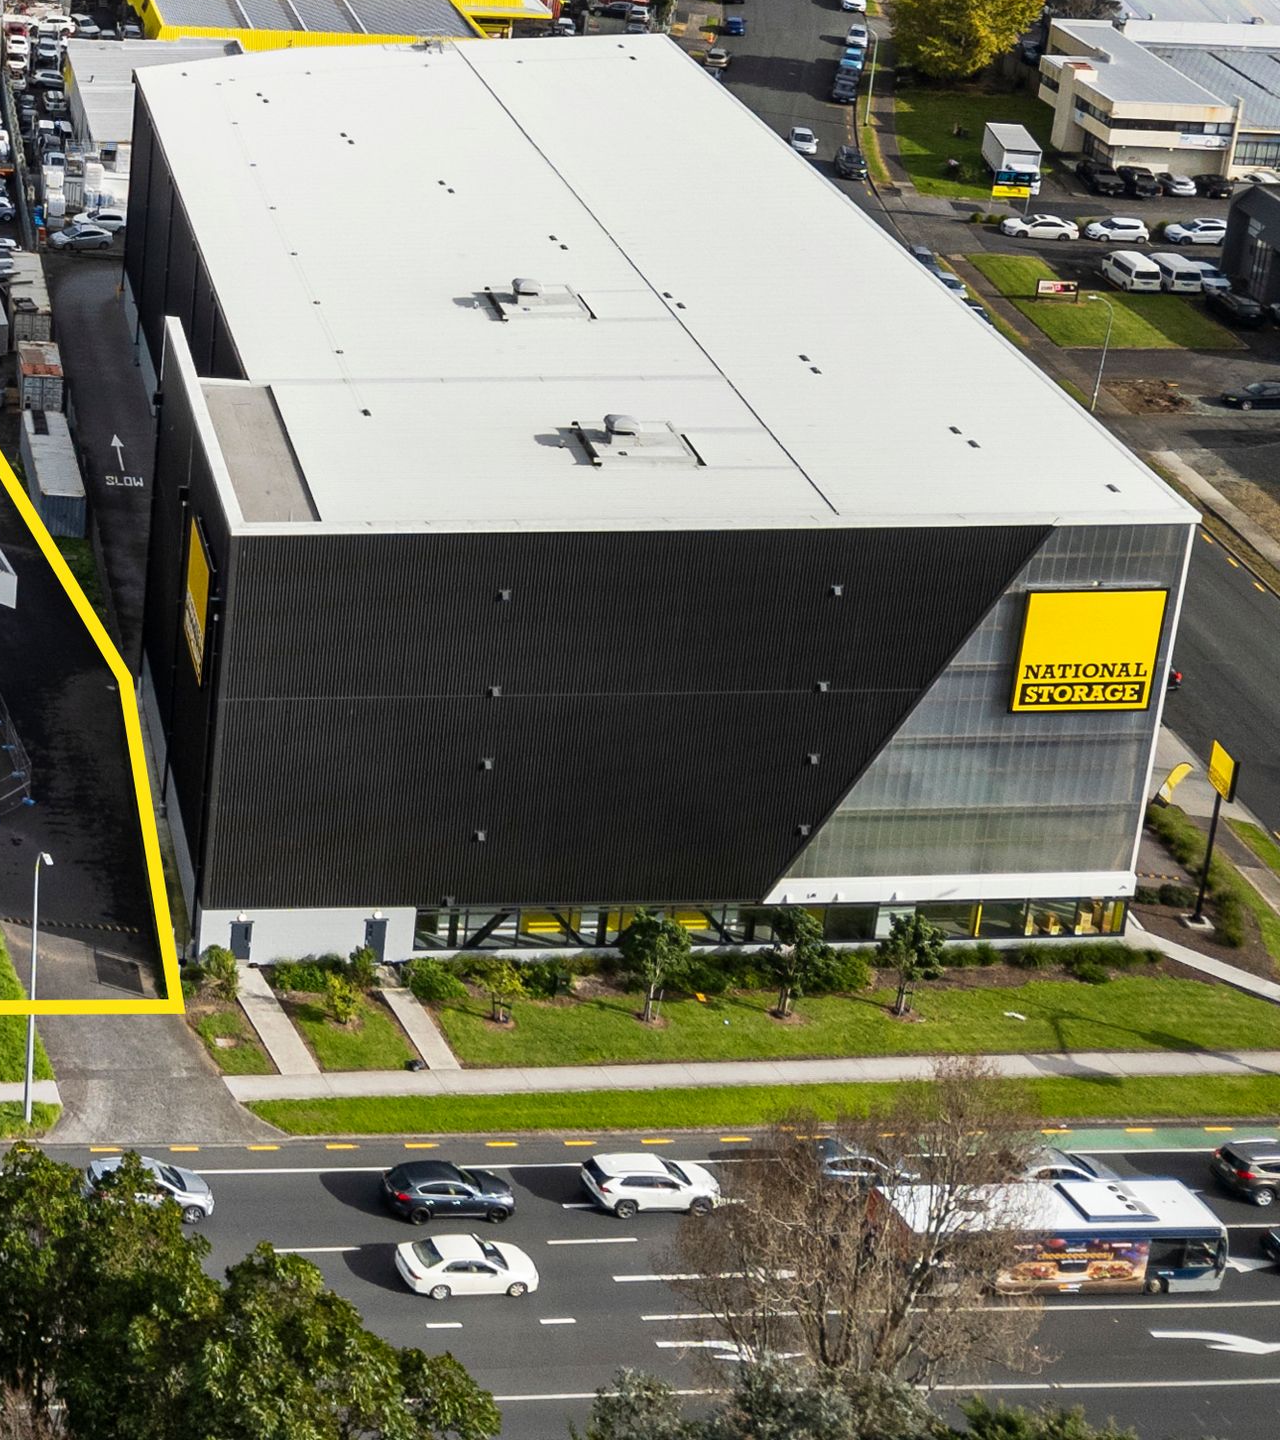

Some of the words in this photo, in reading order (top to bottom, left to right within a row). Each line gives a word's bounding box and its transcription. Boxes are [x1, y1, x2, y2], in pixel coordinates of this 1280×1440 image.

[105, 475, 144, 487] SLOW
[1023, 662, 1148, 680] NATIONAL
[1025, 684, 1140, 704] STORAGE
